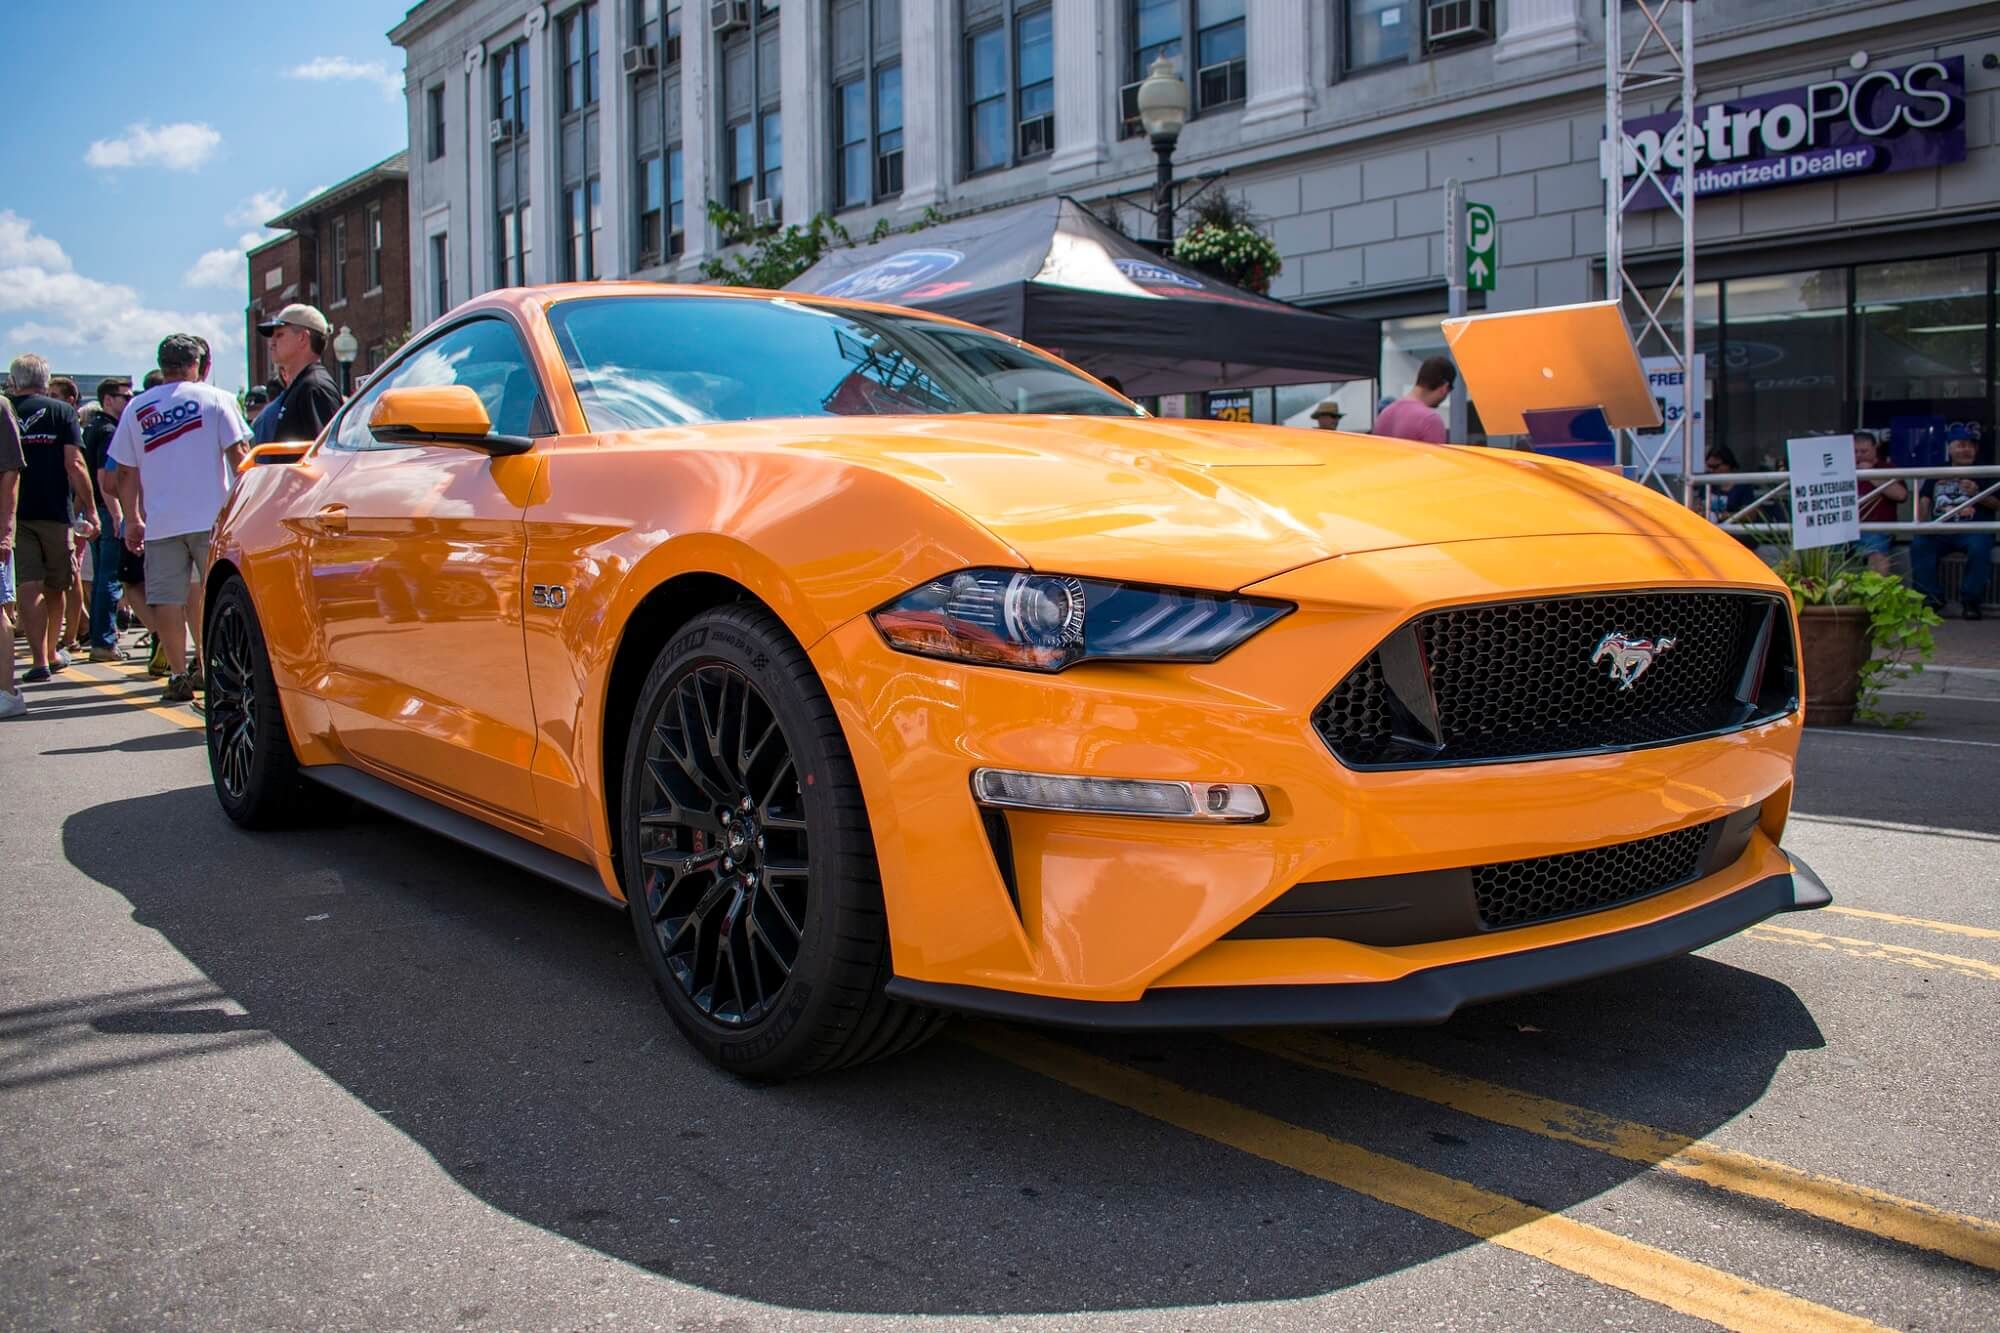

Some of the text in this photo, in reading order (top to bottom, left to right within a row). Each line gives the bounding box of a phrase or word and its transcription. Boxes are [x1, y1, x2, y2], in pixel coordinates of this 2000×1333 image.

[1790, 149, 1867, 177] Dealer
[1471, 211, 1489, 247] P
[1795, 485, 1806, 498] NO
[1797, 501, 1809, 513] OR
[1811, 496, 1840, 512] BICYCLE
[1806, 515, 1815, 528] IN
[1817, 512, 1840, 527] EVENT
